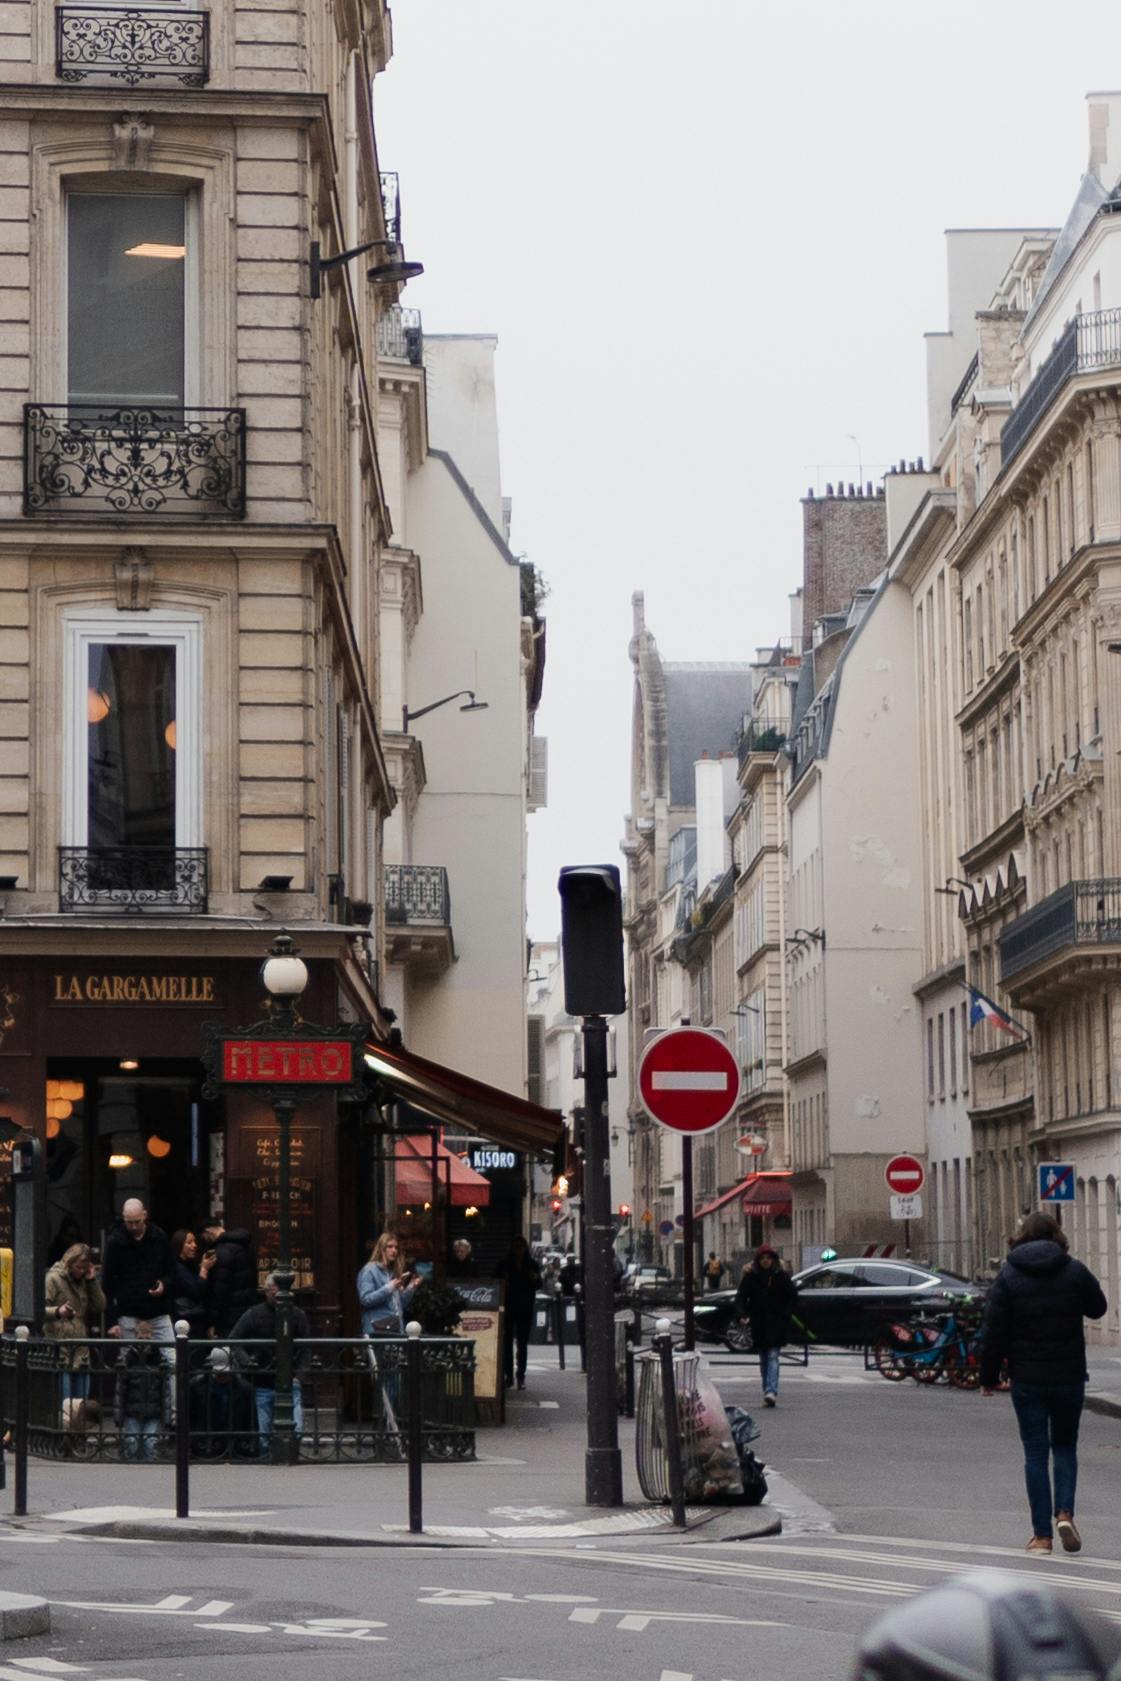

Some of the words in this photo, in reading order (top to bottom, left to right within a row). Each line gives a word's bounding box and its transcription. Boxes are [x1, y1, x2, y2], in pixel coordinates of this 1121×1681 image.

[54, 975, 83, 1001] LA
[86, 975, 215, 1002] GARGAMELLE
[473, 1151, 516, 1168] KISORO
